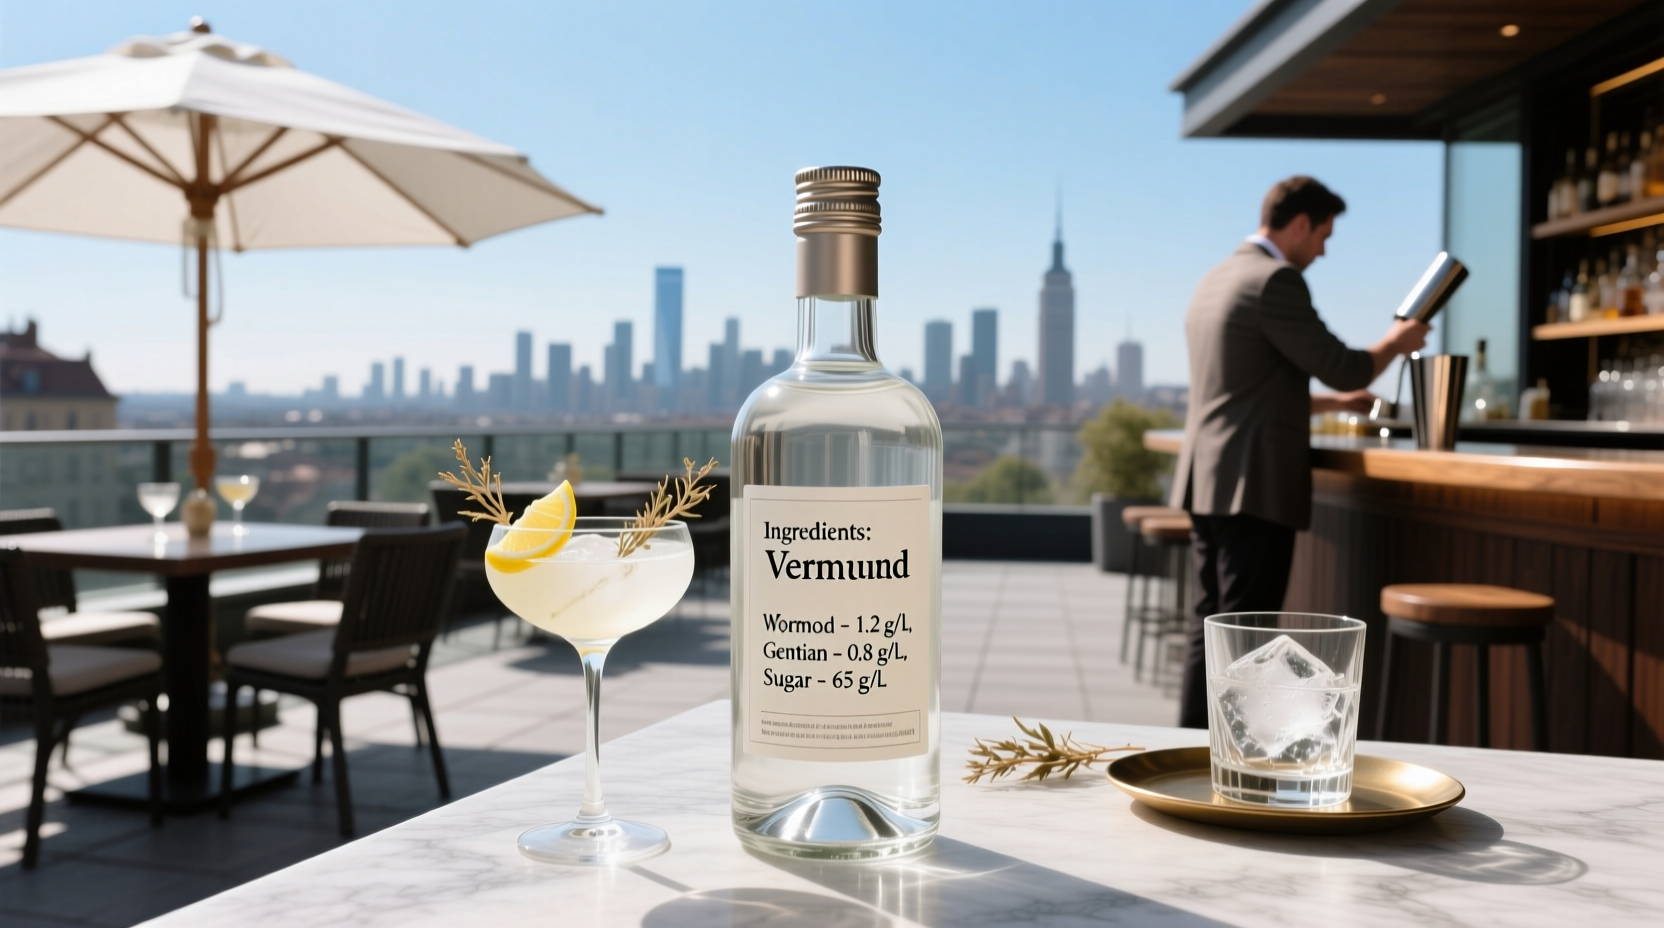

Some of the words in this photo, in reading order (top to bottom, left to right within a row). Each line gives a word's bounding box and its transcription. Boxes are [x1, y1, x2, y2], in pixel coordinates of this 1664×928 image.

[763, 521, 871, 545] Ingredients:
[763, 613, 835, 634] Wormod
[856, 615, 880, 633] 1.2
[883, 613, 912, 638] g/L,
[763, 641, 828, 661] Gentian
[847, 643, 873, 661] 0.8
[877, 642, 908, 666] g/L,
[763, 668, 812, 693] Sugar
[832, 670, 854, 689] 65
[858, 669, 888, 695] g/L
